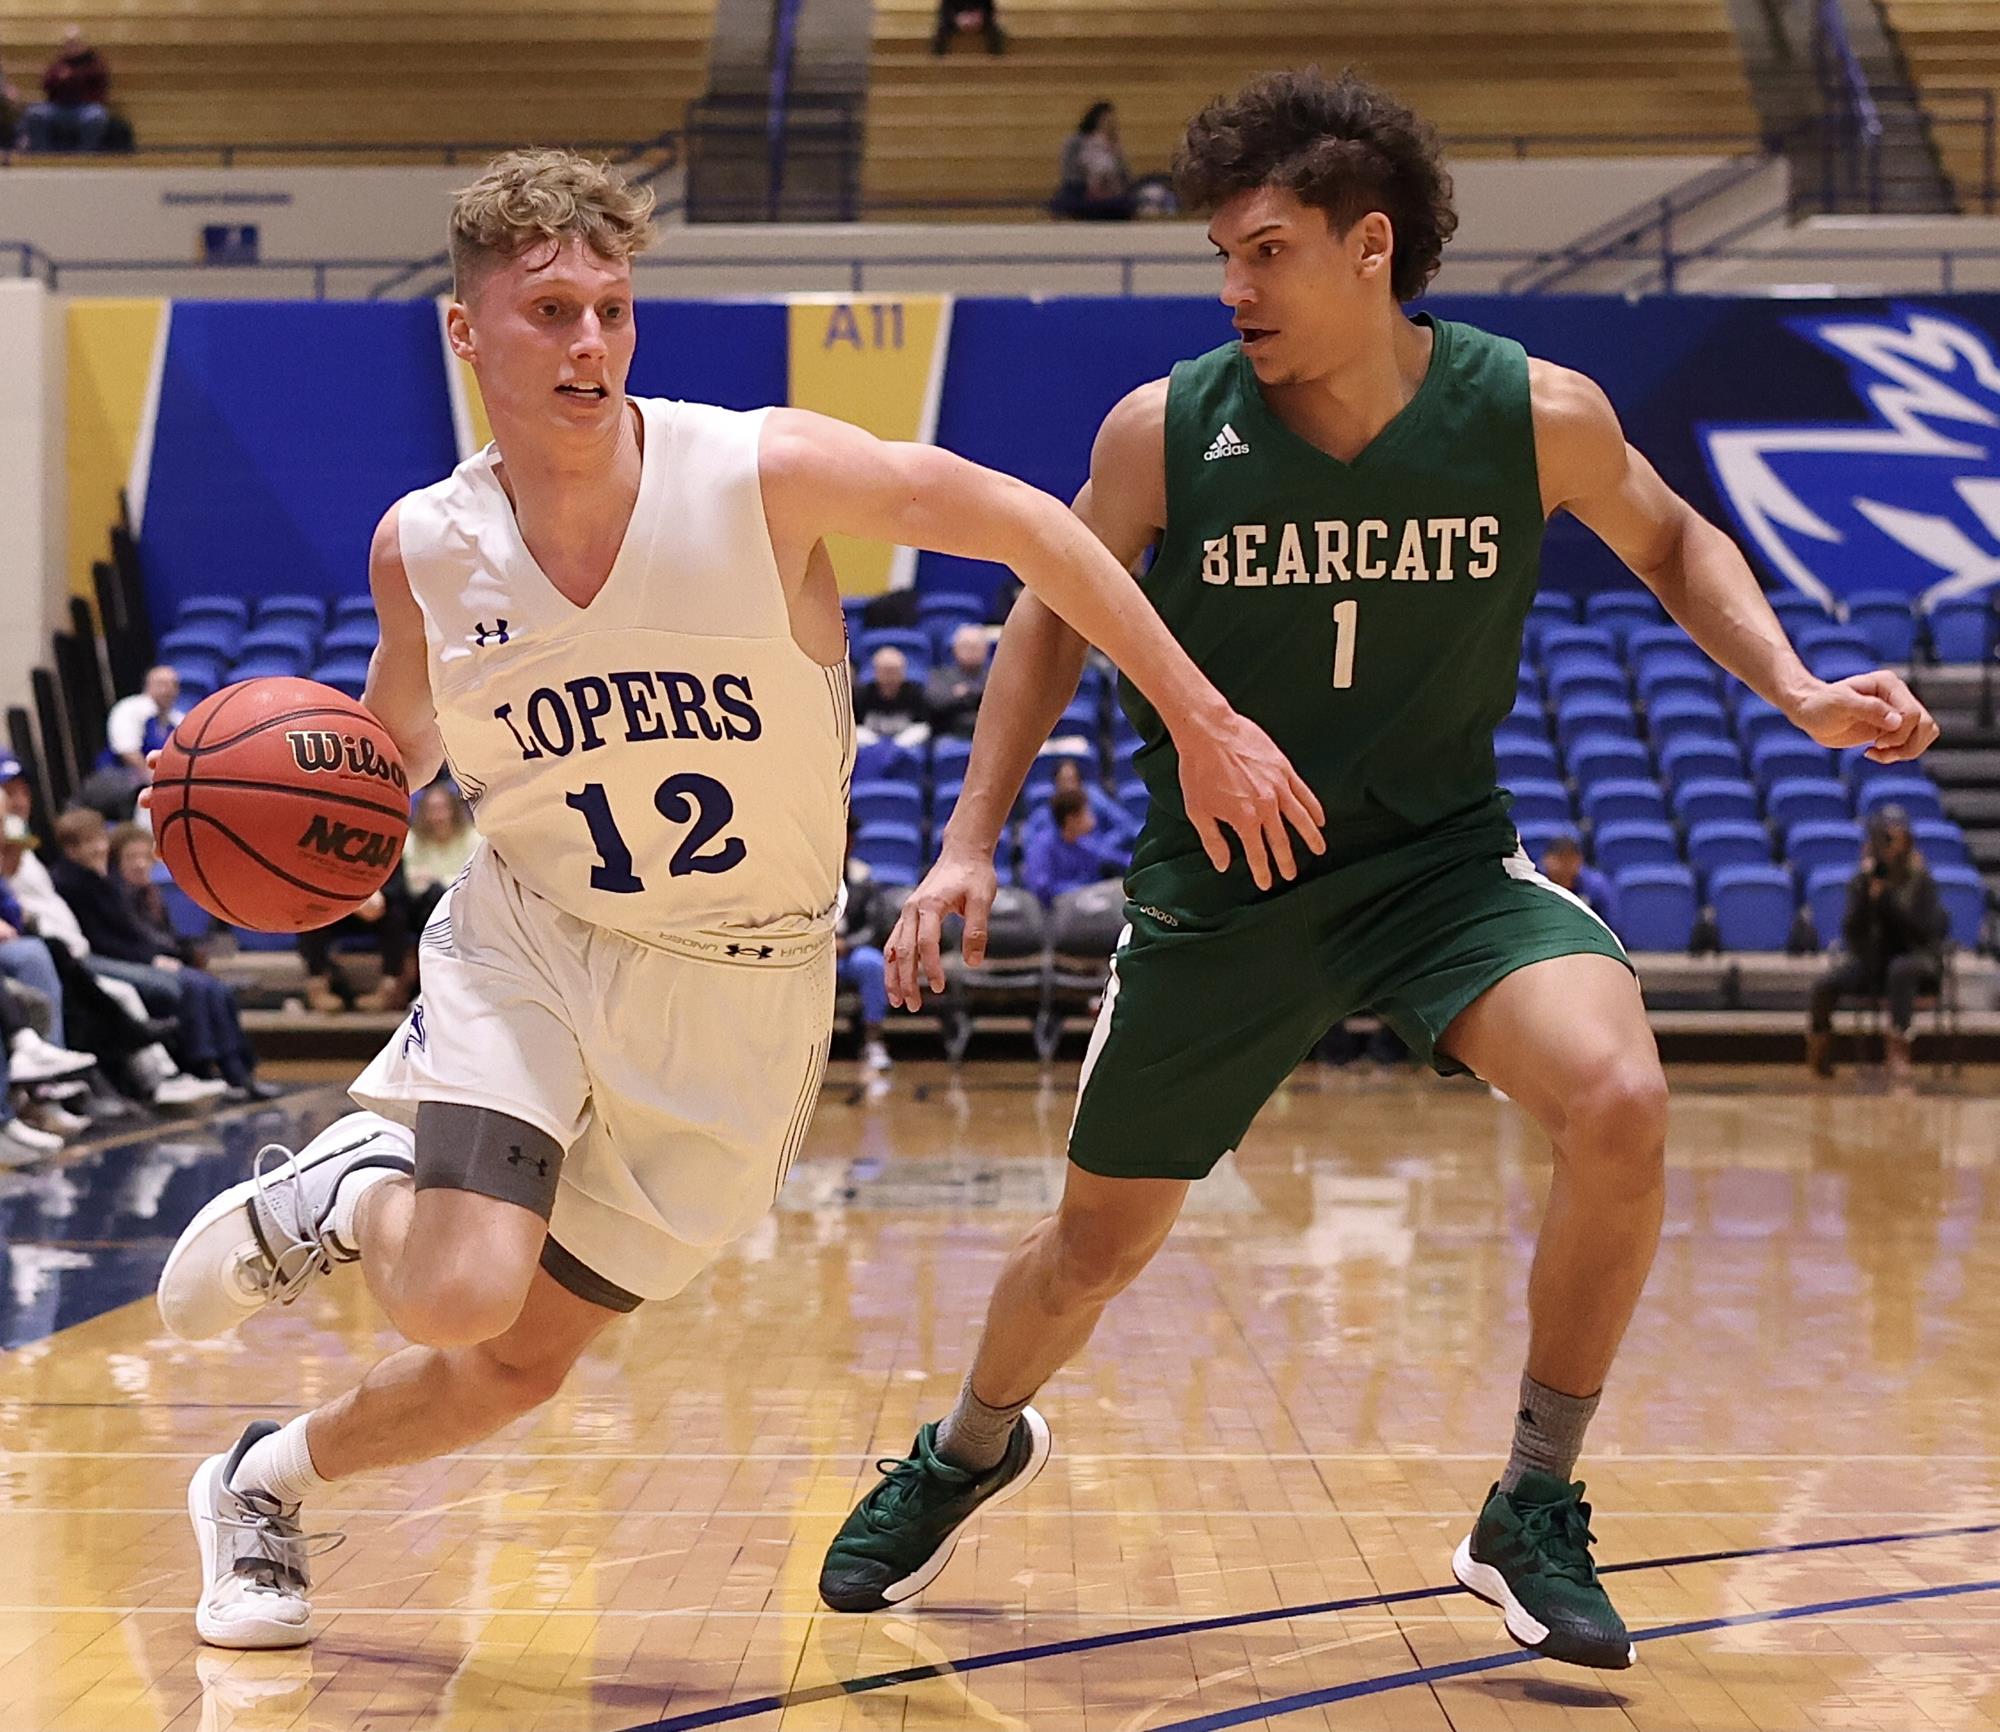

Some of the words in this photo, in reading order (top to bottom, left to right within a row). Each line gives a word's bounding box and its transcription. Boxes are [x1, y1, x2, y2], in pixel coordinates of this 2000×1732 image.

[1203, 443, 1250, 461] adidas
[1202, 515, 1499, 586] BEARCATS
[1332, 600, 1358, 688] 1
[494, 671, 762, 760] LOPERS
[297, 814, 398, 868] NCAA
[565, 772, 747, 893] 12
[659, 931, 719, 952] UNDER
